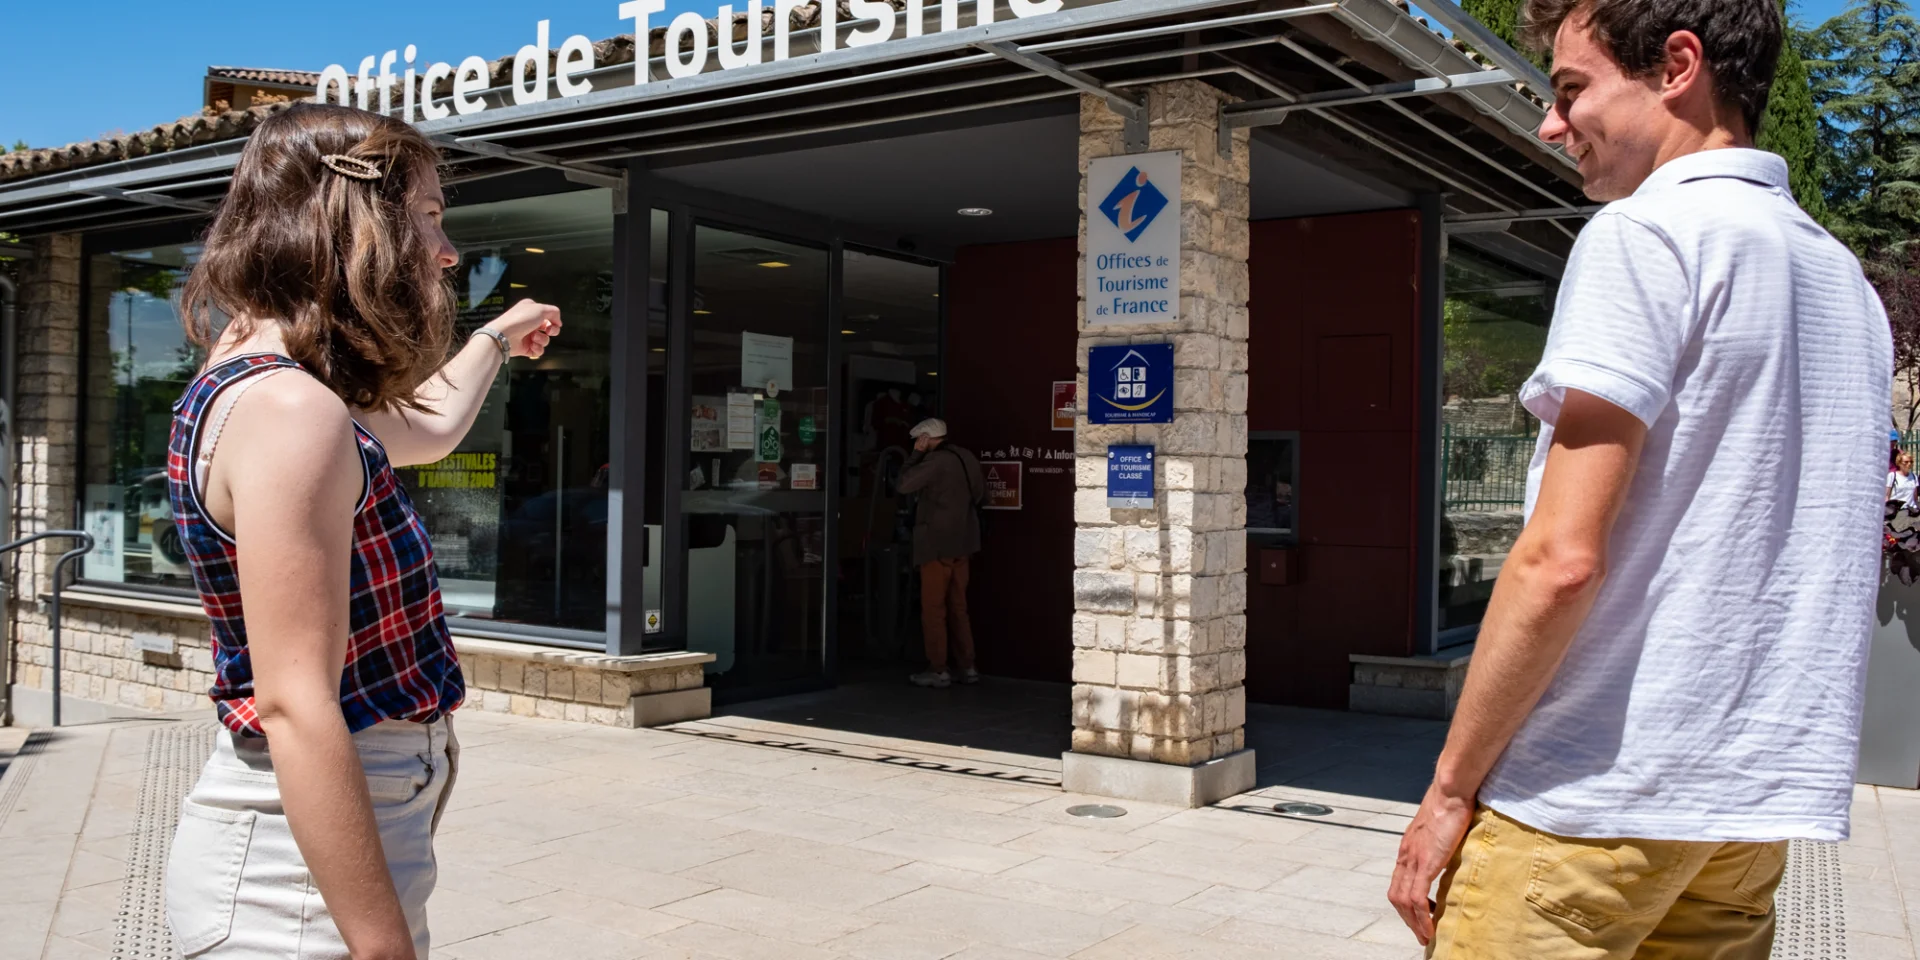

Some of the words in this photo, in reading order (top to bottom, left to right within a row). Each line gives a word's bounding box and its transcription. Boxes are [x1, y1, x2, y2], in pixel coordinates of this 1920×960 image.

[316, 43, 490, 124] Office
[512, 19, 595, 107] de
[1096, 253, 1151, 270] Offices
[1156, 255, 1169, 267] de
[1097, 275, 1169, 292] Tourisme
[1096, 304, 1109, 316] de
[1113, 298, 1169, 315] France
[1054, 449, 1077, 460] Infor
[470, 471, 496, 488] 2000
[1118, 472, 1143, 480] CLASSÉ
